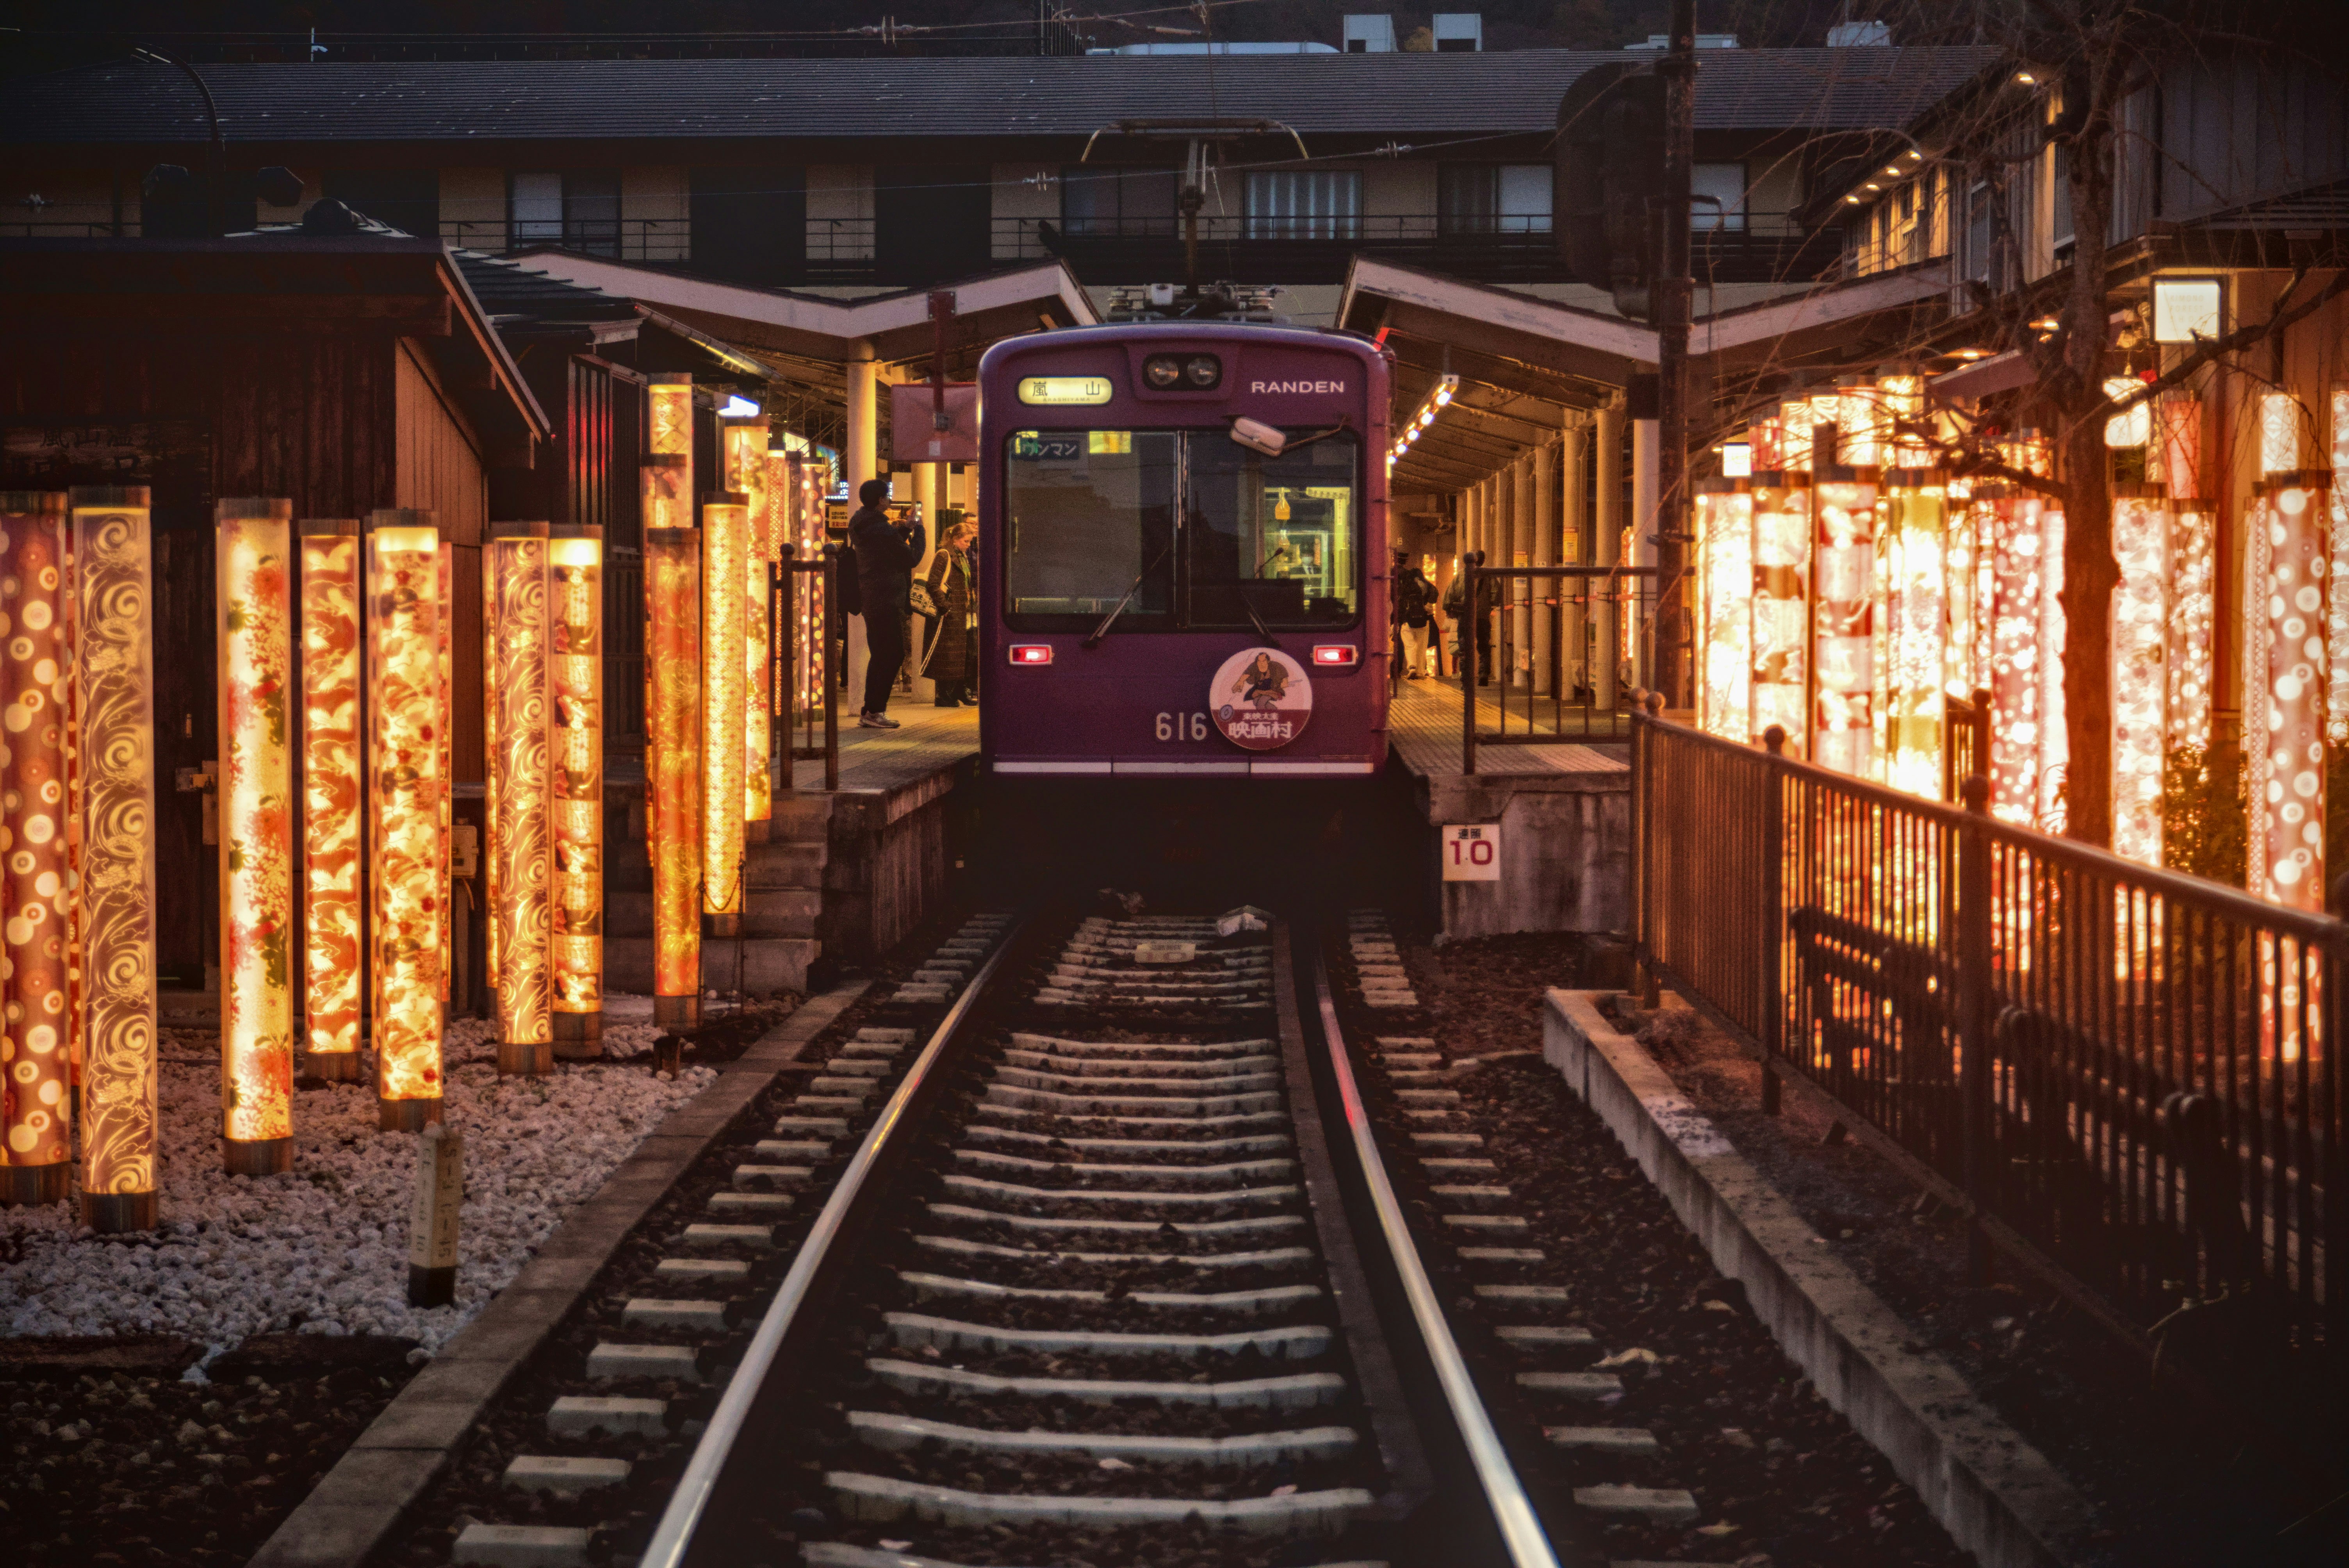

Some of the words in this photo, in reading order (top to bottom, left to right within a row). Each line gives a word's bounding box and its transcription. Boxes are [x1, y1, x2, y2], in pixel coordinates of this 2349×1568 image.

[1032, 381, 1100, 396] 嵐山
[1251, 380, 1344, 394] RANDEN
[1022, 443, 1077, 456] ワンマン
[1155, 712, 1207, 741] 616
[1228, 721, 1292, 739] 映画村
[1449, 840, 1493, 865] 10
